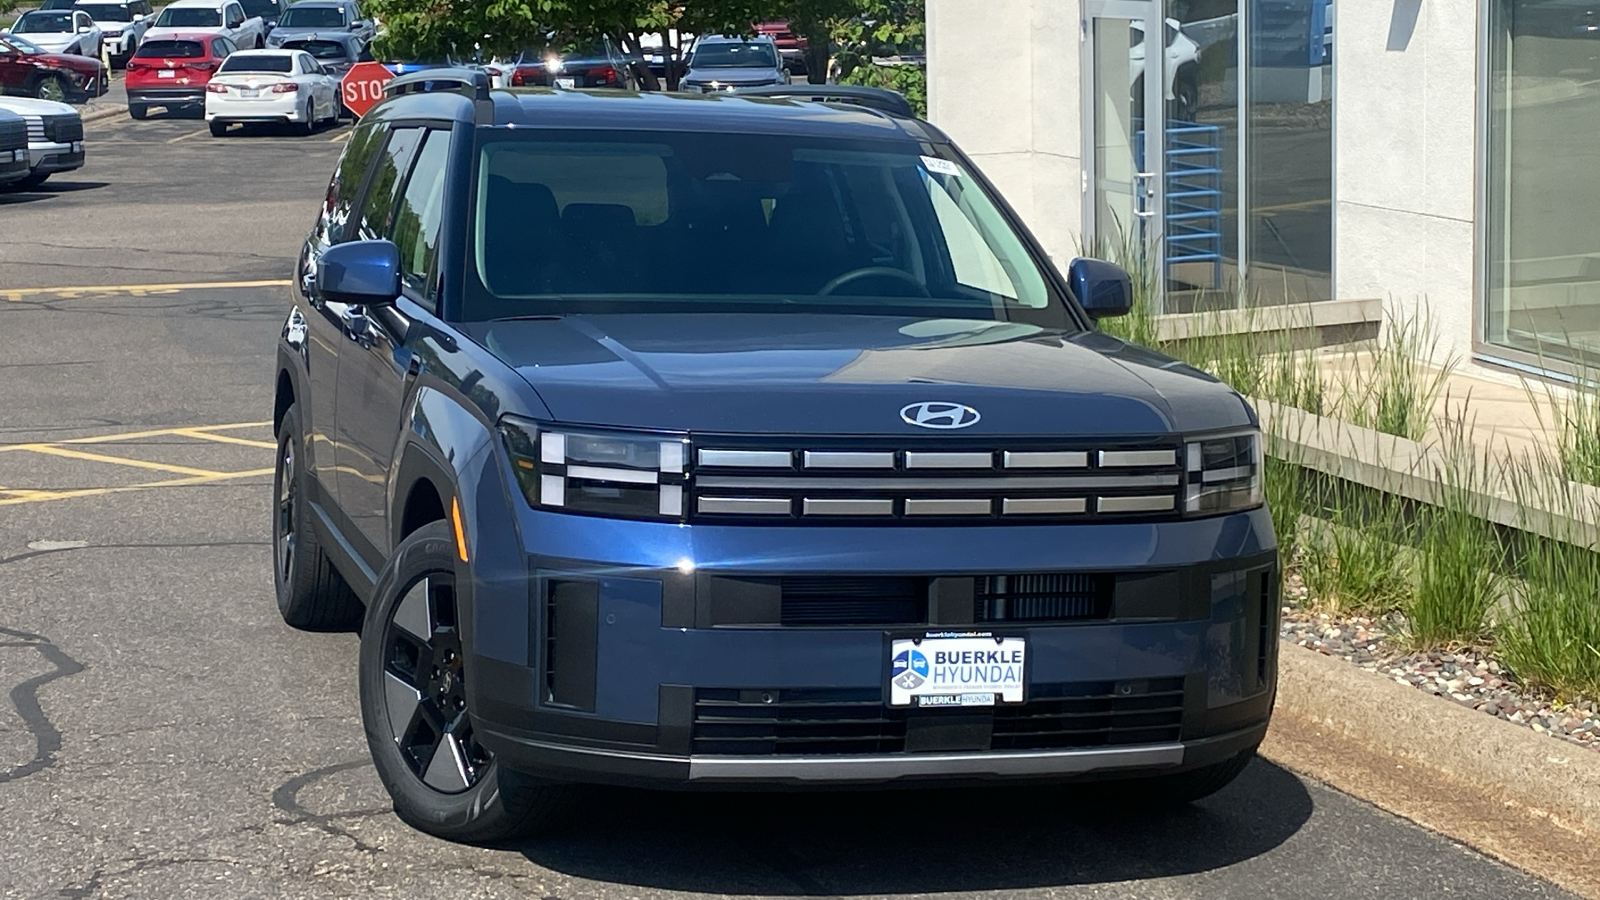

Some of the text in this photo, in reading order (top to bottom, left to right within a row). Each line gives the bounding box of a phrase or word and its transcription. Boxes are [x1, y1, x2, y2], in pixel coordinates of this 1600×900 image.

[935, 651, 1022, 664] BUERKLE
[933, 665, 1022, 683] HYUNDAI
[920, 695, 993, 705] BUERKLE HYUNDAI
